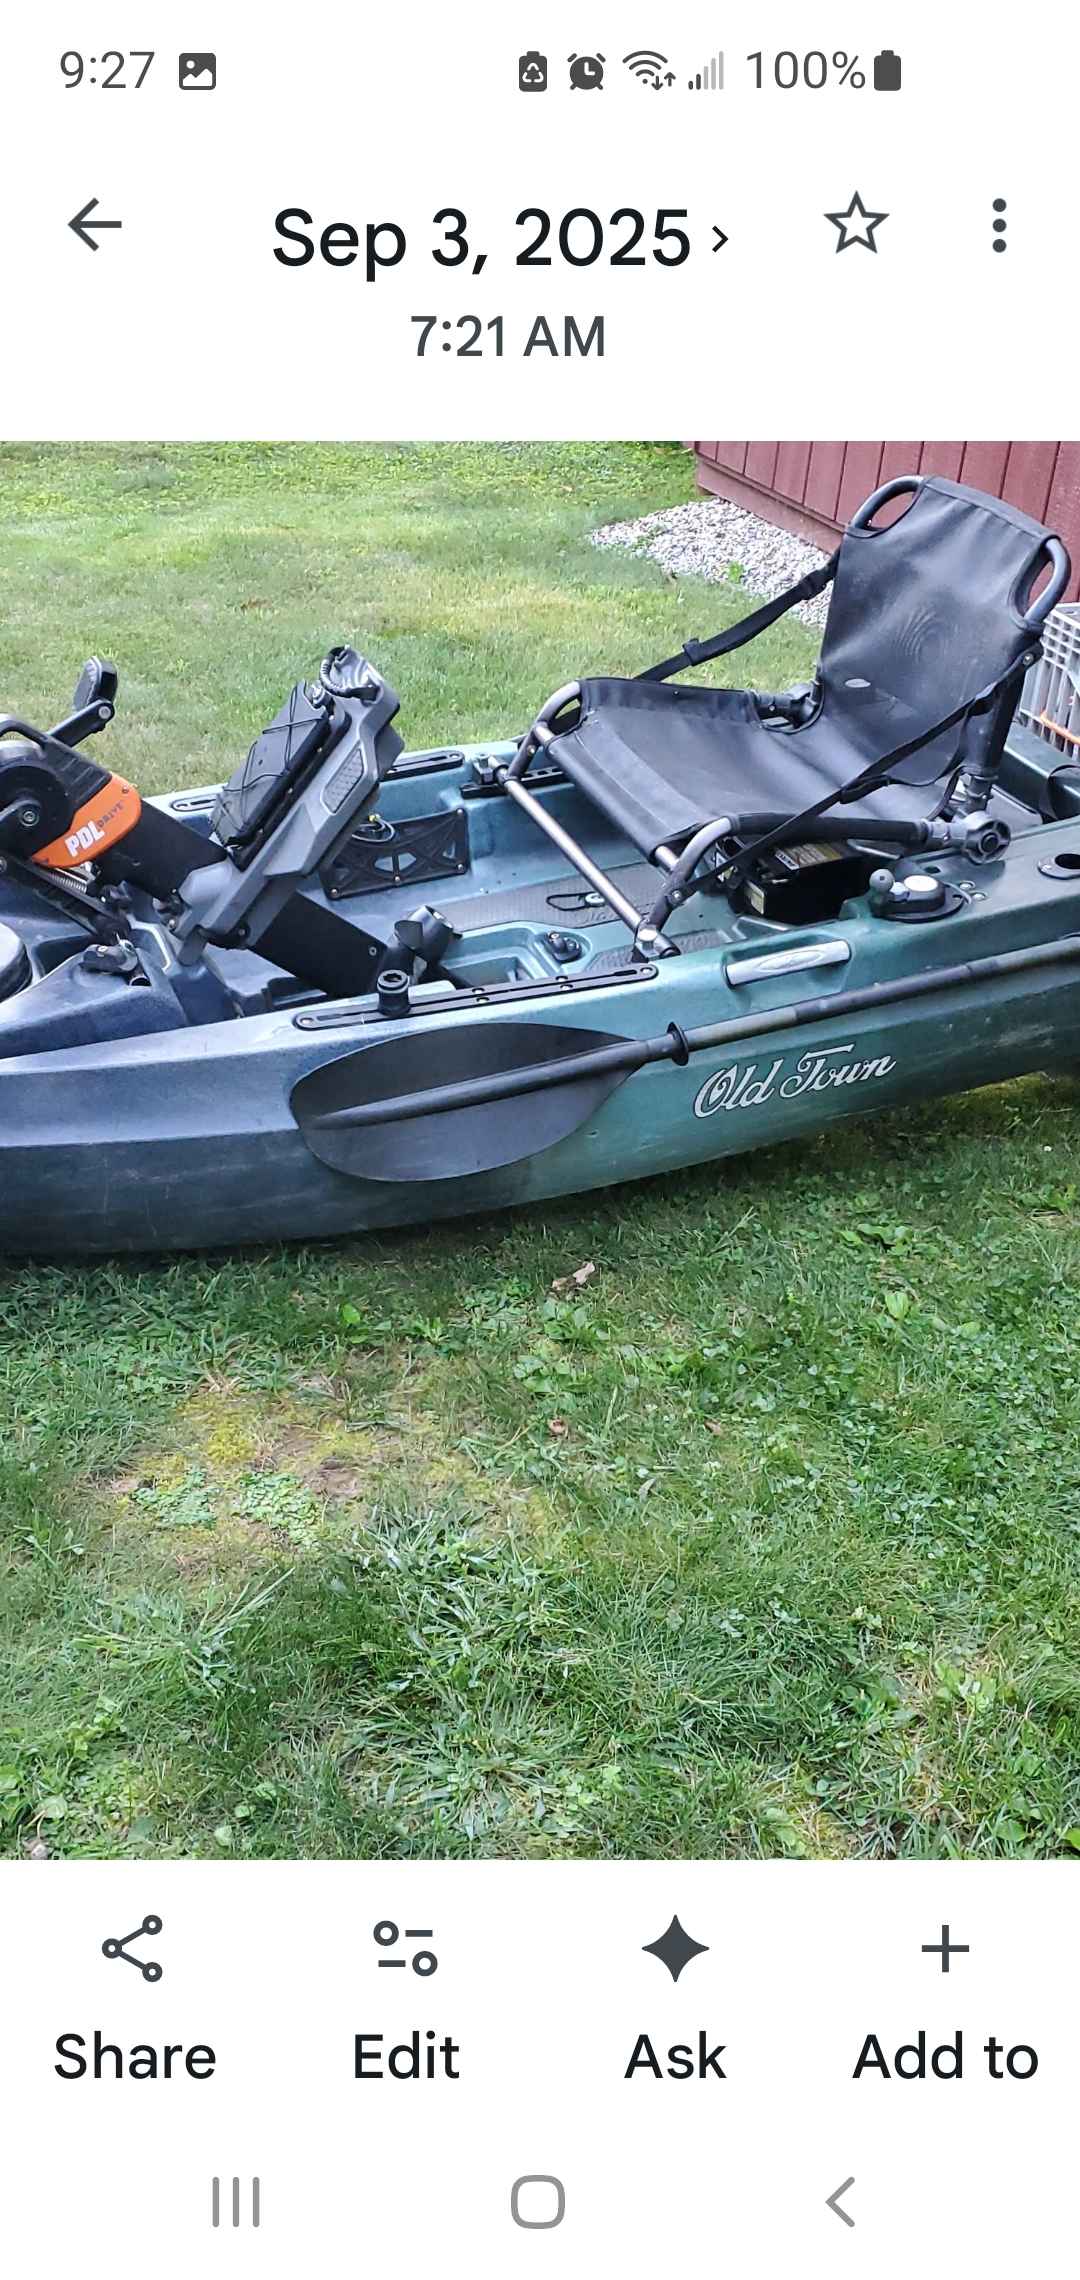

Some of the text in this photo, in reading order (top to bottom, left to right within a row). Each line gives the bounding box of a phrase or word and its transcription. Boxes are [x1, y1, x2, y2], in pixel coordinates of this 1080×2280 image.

[65, 820, 105, 857] PDL
[694, 1044, 897, 1118] Old Town
